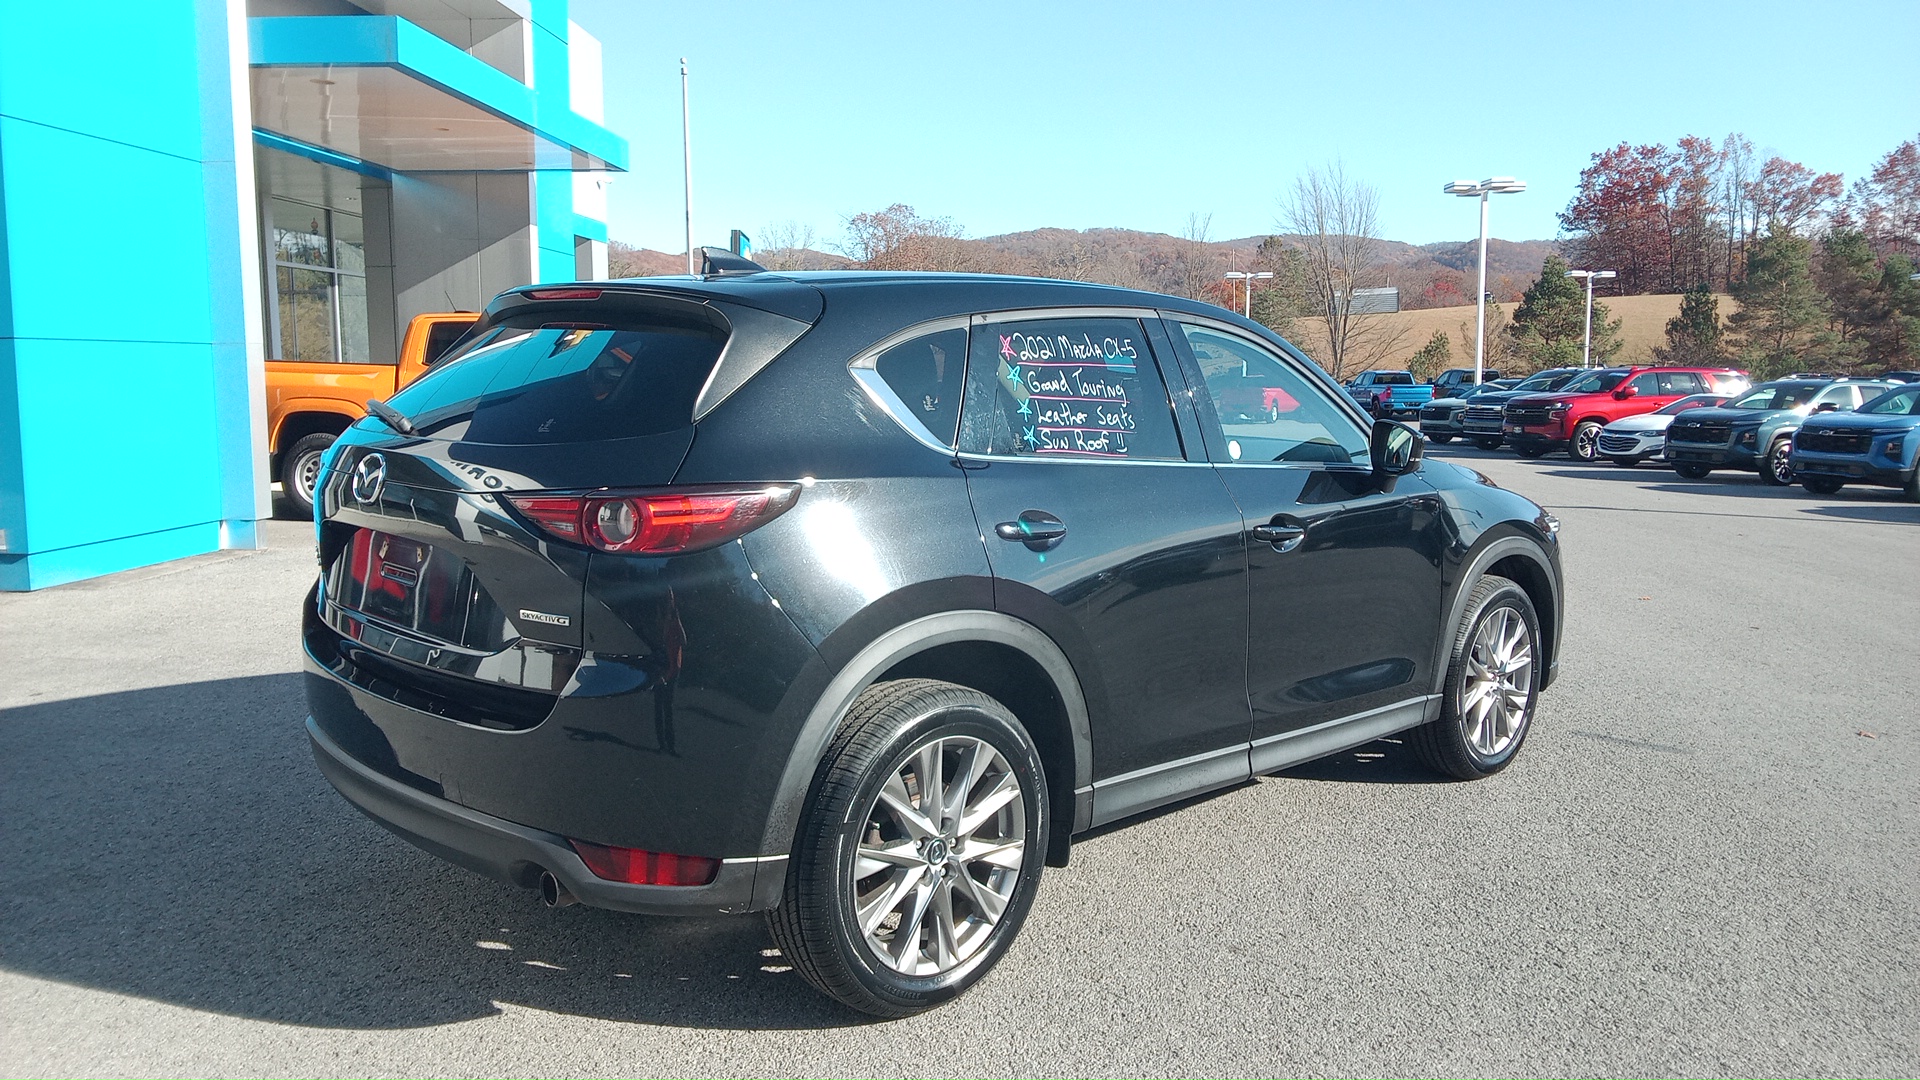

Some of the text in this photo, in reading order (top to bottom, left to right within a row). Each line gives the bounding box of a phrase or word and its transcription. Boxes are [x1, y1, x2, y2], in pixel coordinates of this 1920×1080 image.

[1012, 332, 1056, 360] 2021
[1104, 337, 1137, 359] CX-5
[1027, 367, 1127, 408] Grand Touring
[1035, 400, 1136, 430] Leather Seats
[1041, 429, 1109, 452] Sun Roof
